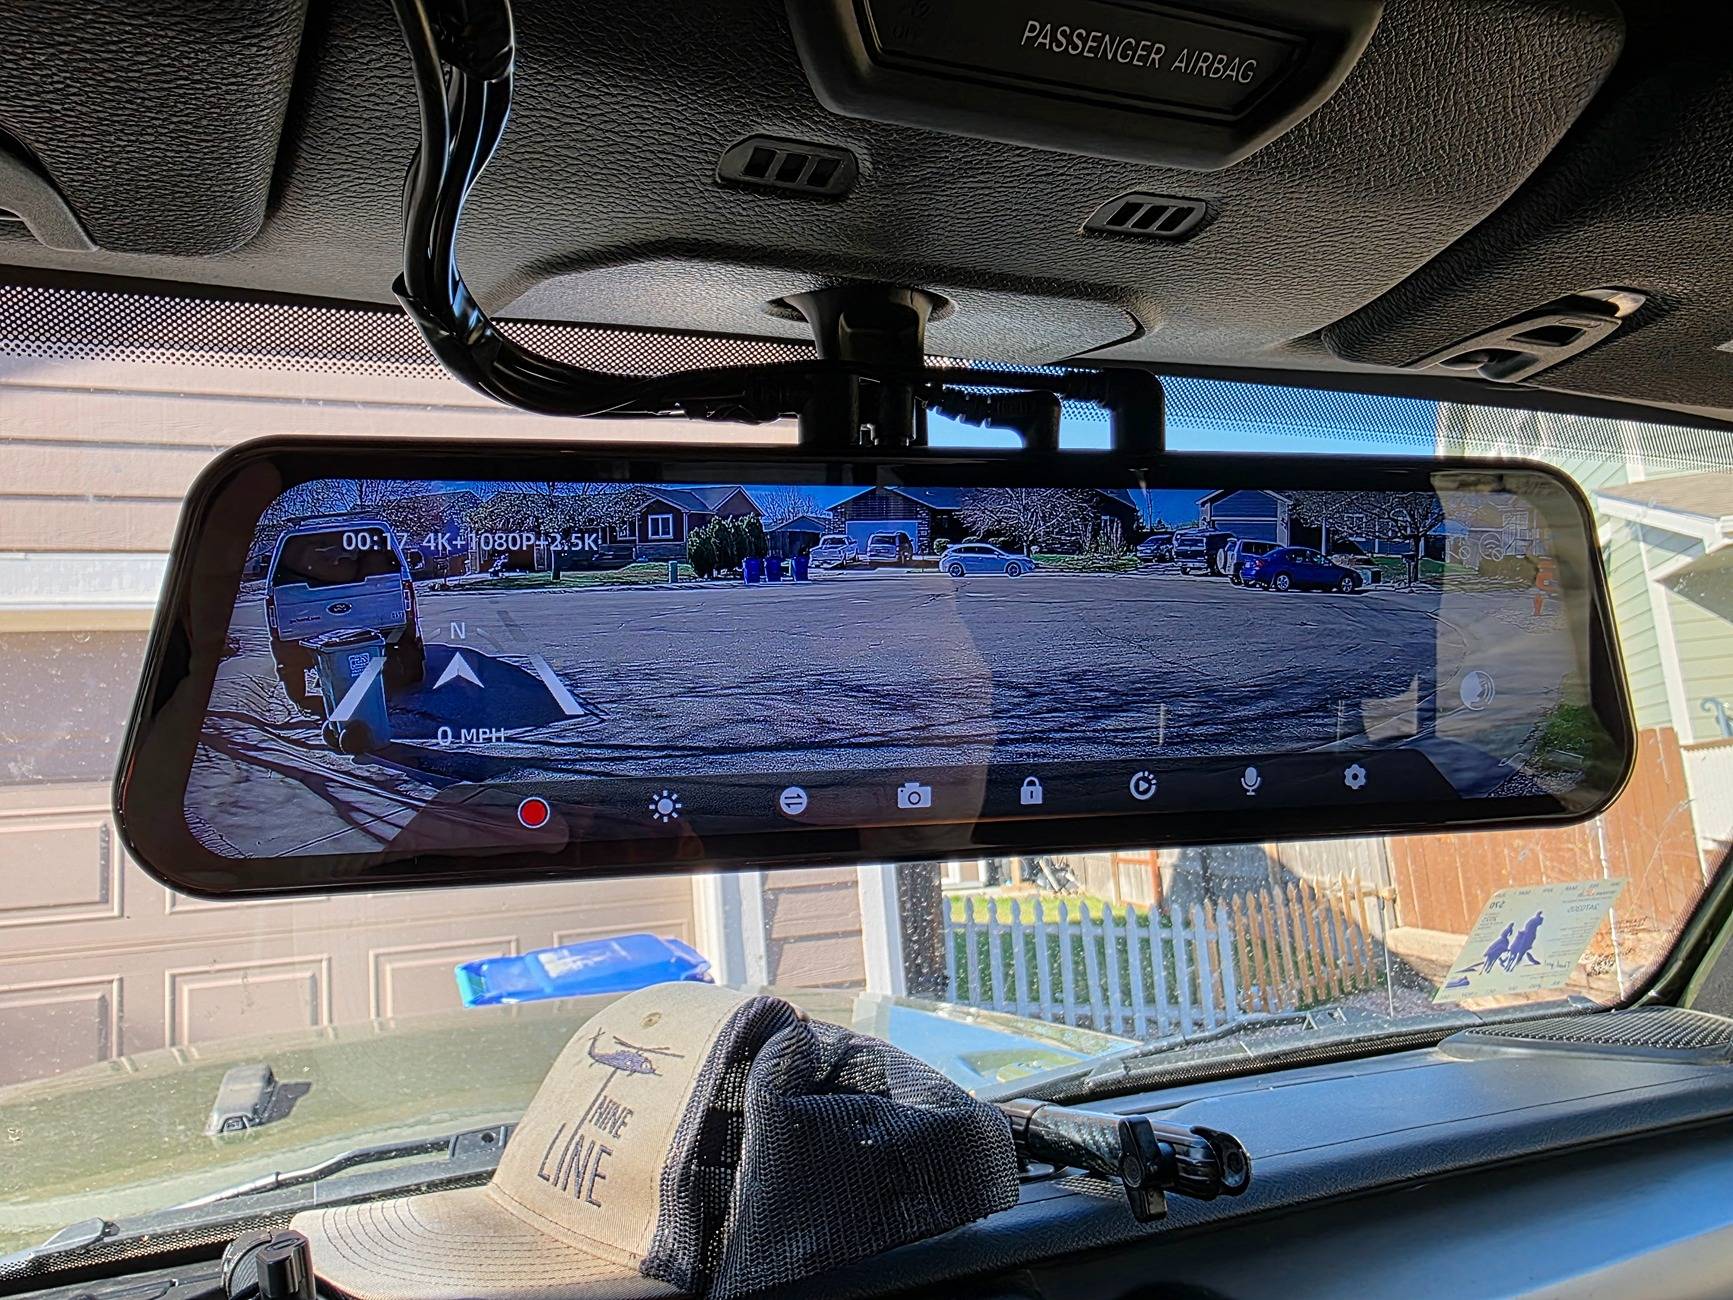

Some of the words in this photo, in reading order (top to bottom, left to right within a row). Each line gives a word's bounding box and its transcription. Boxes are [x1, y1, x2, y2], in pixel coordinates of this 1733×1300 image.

[1020, 20, 1166, 69] PASSENGER
[1171, 48, 1257, 84] AIRBAG
[342, 532, 406, 551] 00:17
[422, 532, 598, 551] 4K+1080P+2.5K
[450, 622, 466, 639] N
[437, 726, 452, 746] 0
[461, 728, 505, 744] MPH
[589, 1096, 633, 1139] NINE
[538, 1123, 613, 1208] LINE
